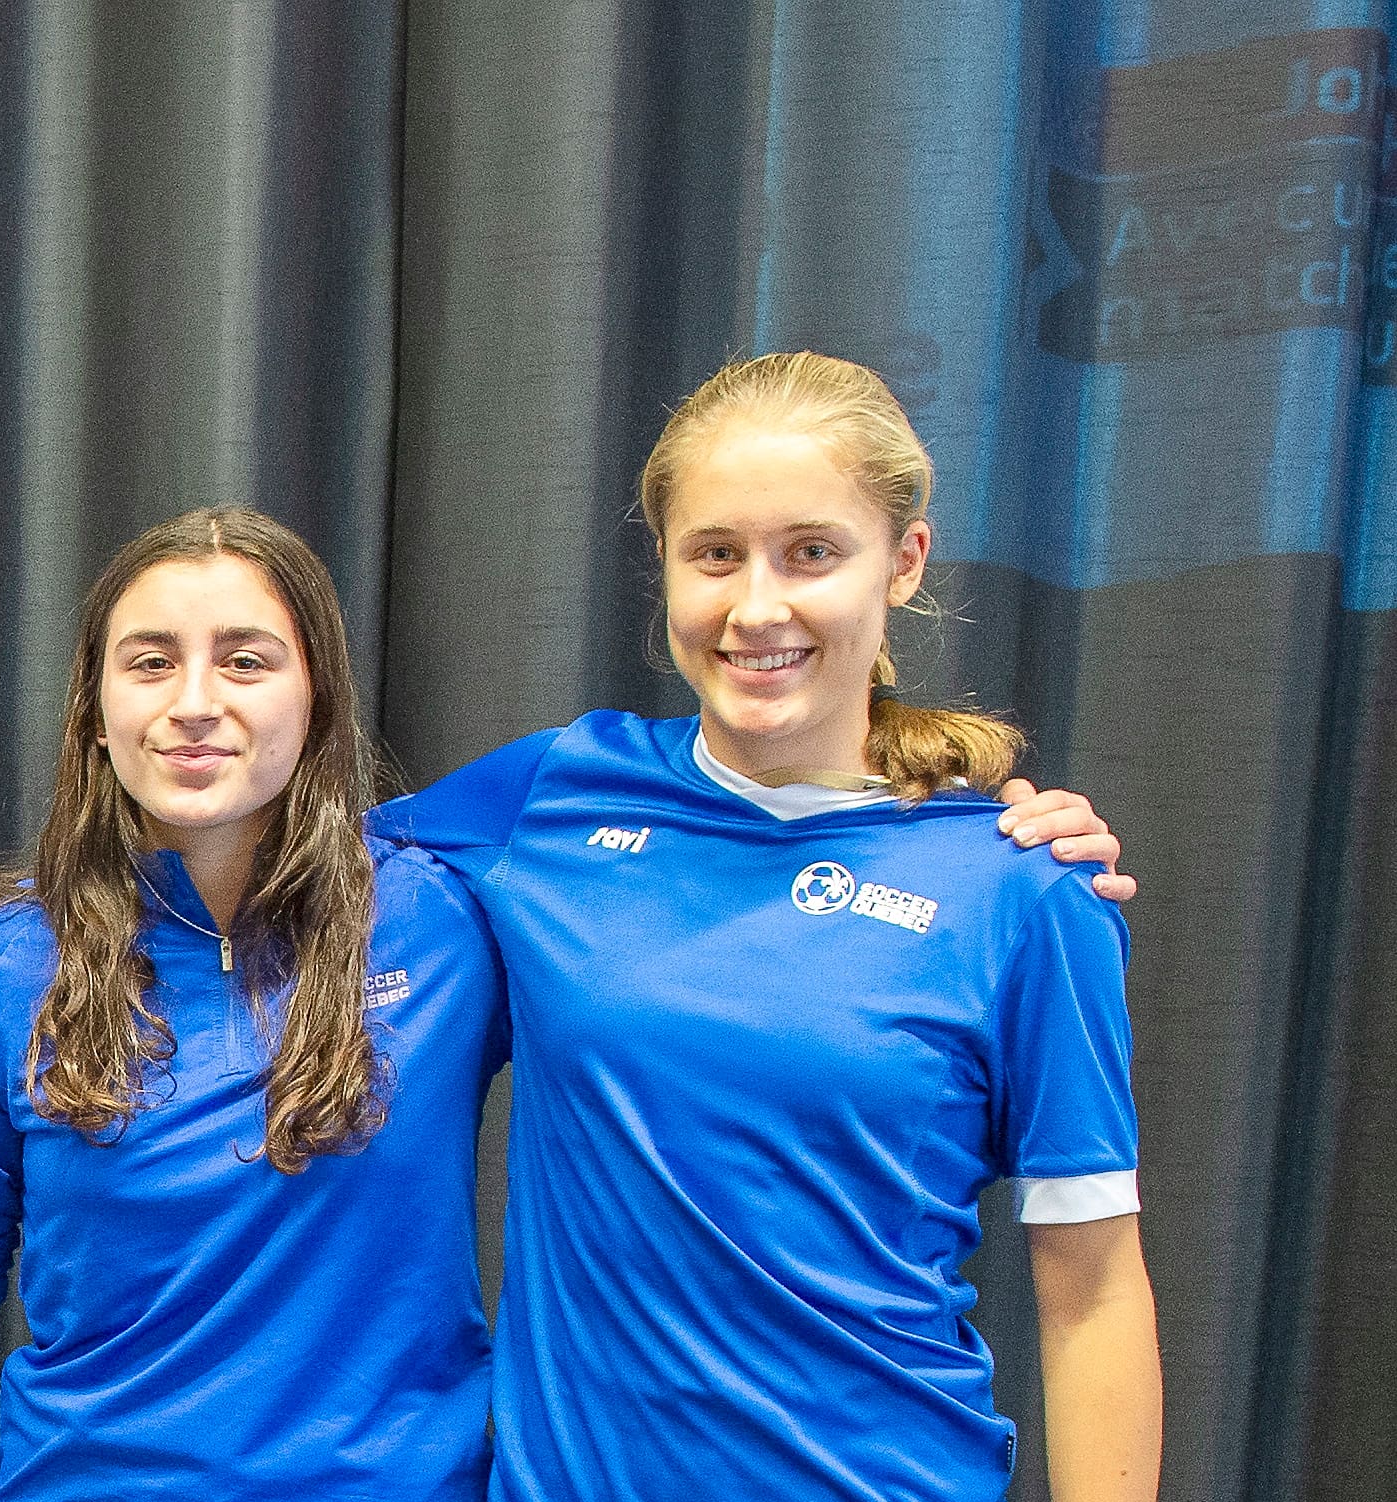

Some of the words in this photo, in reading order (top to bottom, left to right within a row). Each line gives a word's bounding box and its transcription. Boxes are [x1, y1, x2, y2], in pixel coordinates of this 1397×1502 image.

[587, 827, 651, 854] savi
[856, 882, 939, 914] SOCCER
[365, 970, 409, 990] CCER
[366, 986, 411, 1009] ÉBEC
